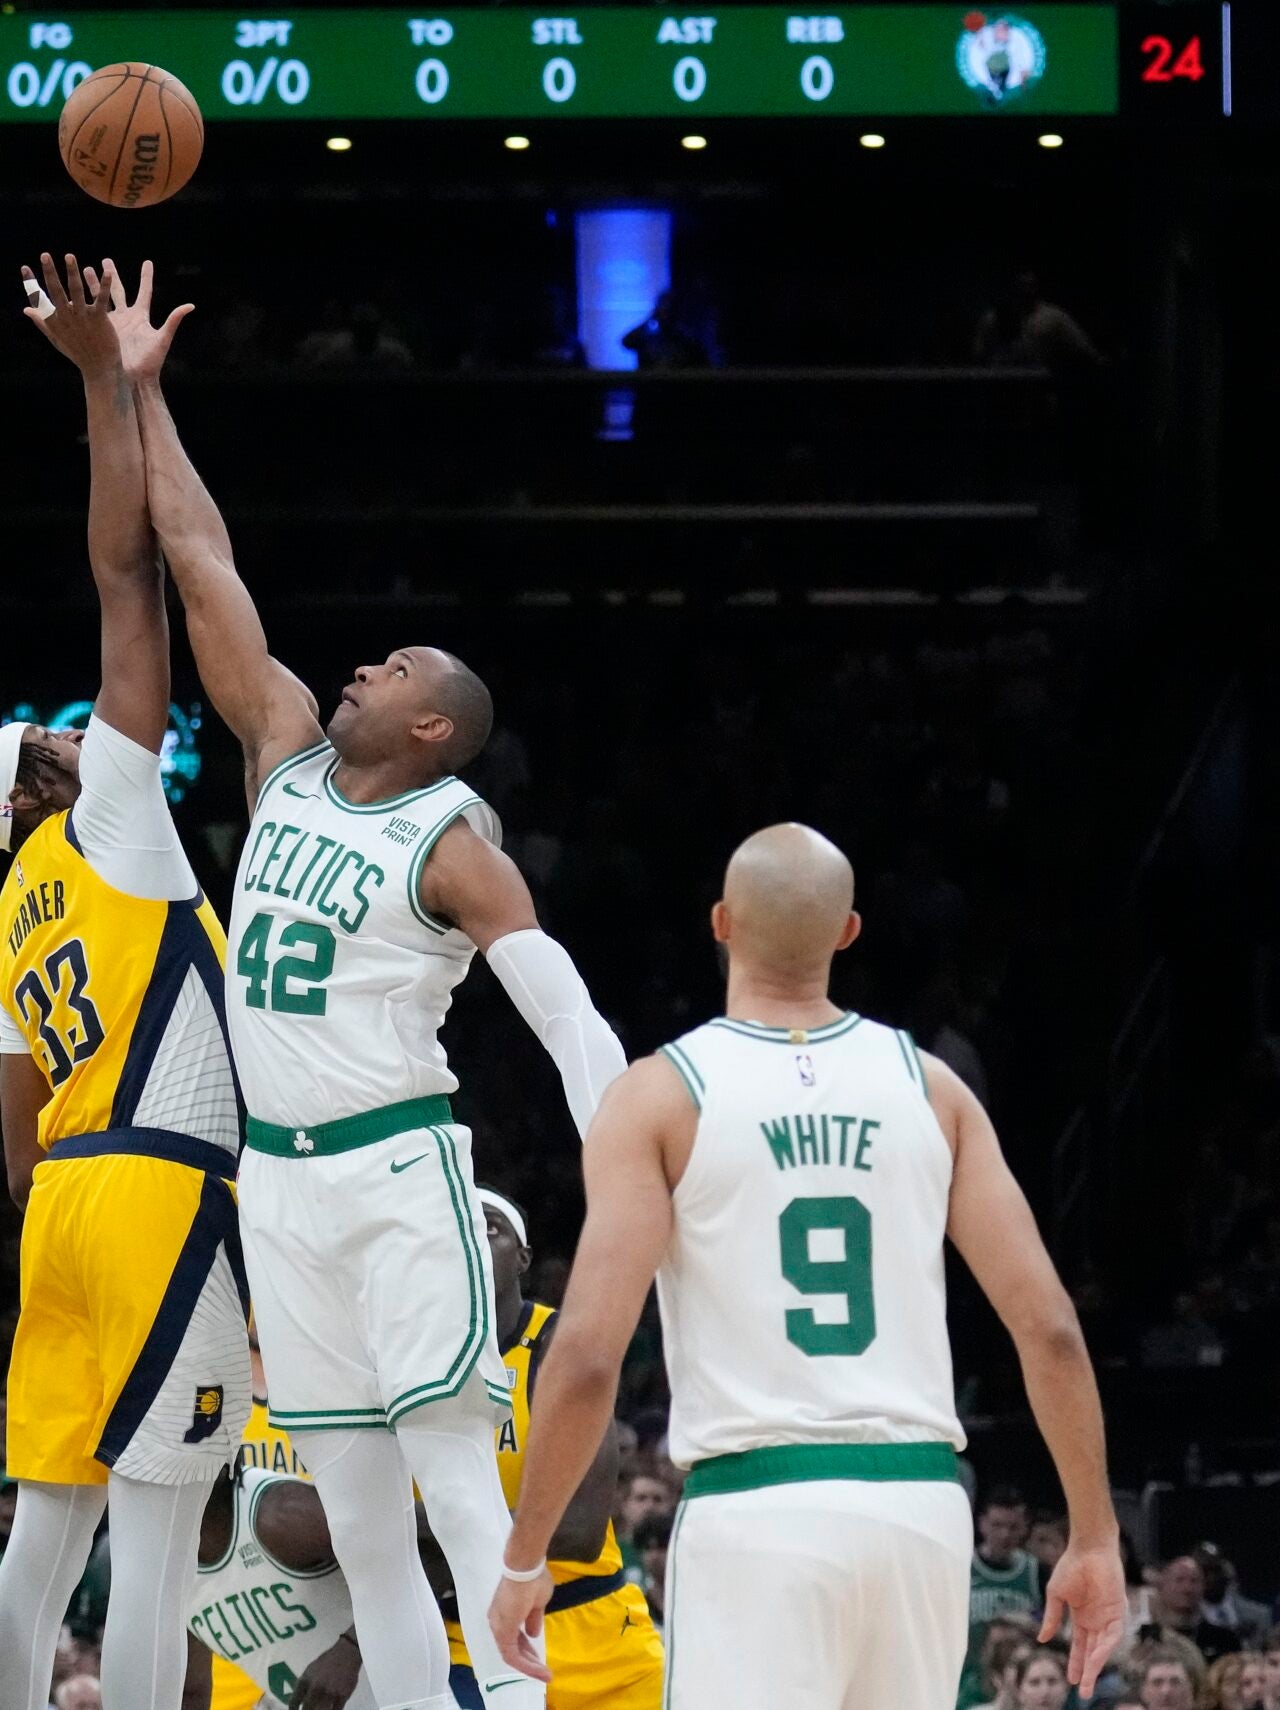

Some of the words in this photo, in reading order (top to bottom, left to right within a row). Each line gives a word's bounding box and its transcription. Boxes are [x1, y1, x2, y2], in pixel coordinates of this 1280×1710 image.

[31, 24, 72, 49] FG
[236, 21, 290, 47] 3PT
[410, 20, 453, 46] TO
[532, 19, 582, 45] STL
[658, 17, 716, 44] AST
[787, 17, 844, 43] REB
[1140, 35, 1206, 82] 24
[221, 59, 310, 105] 0/0
[415, 58, 448, 103] 0
[543, 58, 576, 102] 0
[673, 57, 707, 101] 0
[800, 56, 833, 100] 0
[380, 827, 414, 847] PRINT
[388, 816, 421, 839] VISTA
[243, 820, 385, 935] CELTICS
[8, 880, 65, 958] TURNER
[237, 912, 337, 1017] 42
[14, 939, 106, 1089] 33
[760, 1114, 881, 1172] WHITE
[778, 1196, 877, 1357] 9
[191, 1582, 318, 1662] CELTICS
